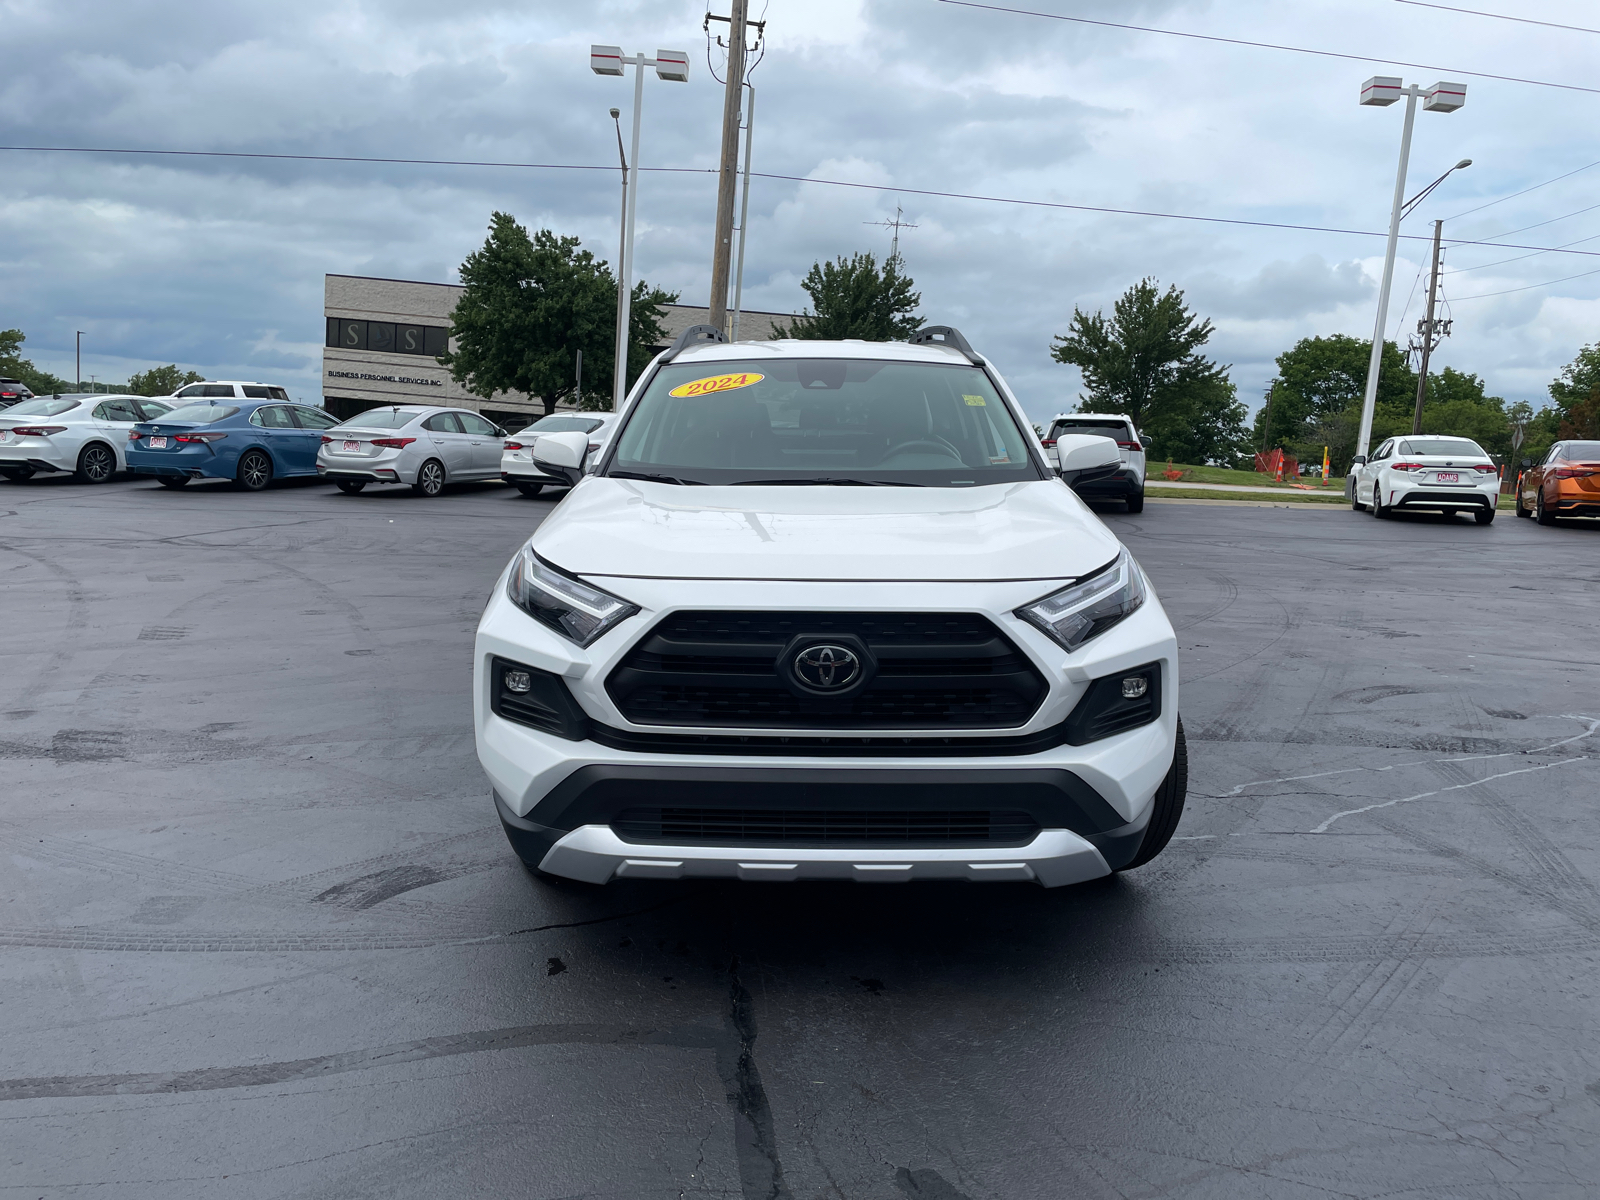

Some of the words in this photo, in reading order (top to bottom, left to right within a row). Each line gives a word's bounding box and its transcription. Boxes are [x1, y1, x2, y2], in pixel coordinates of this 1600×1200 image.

[346, 324, 359, 345] S
[405, 329, 417, 350] S
[328, 370, 359, 379] BUSINESS
[360, 373, 397, 382] PERSONNEL
[398, 376, 429, 385] SERVICES
[687, 374, 748, 395] 2024
[1438, 473, 1458, 481] ADAMS
